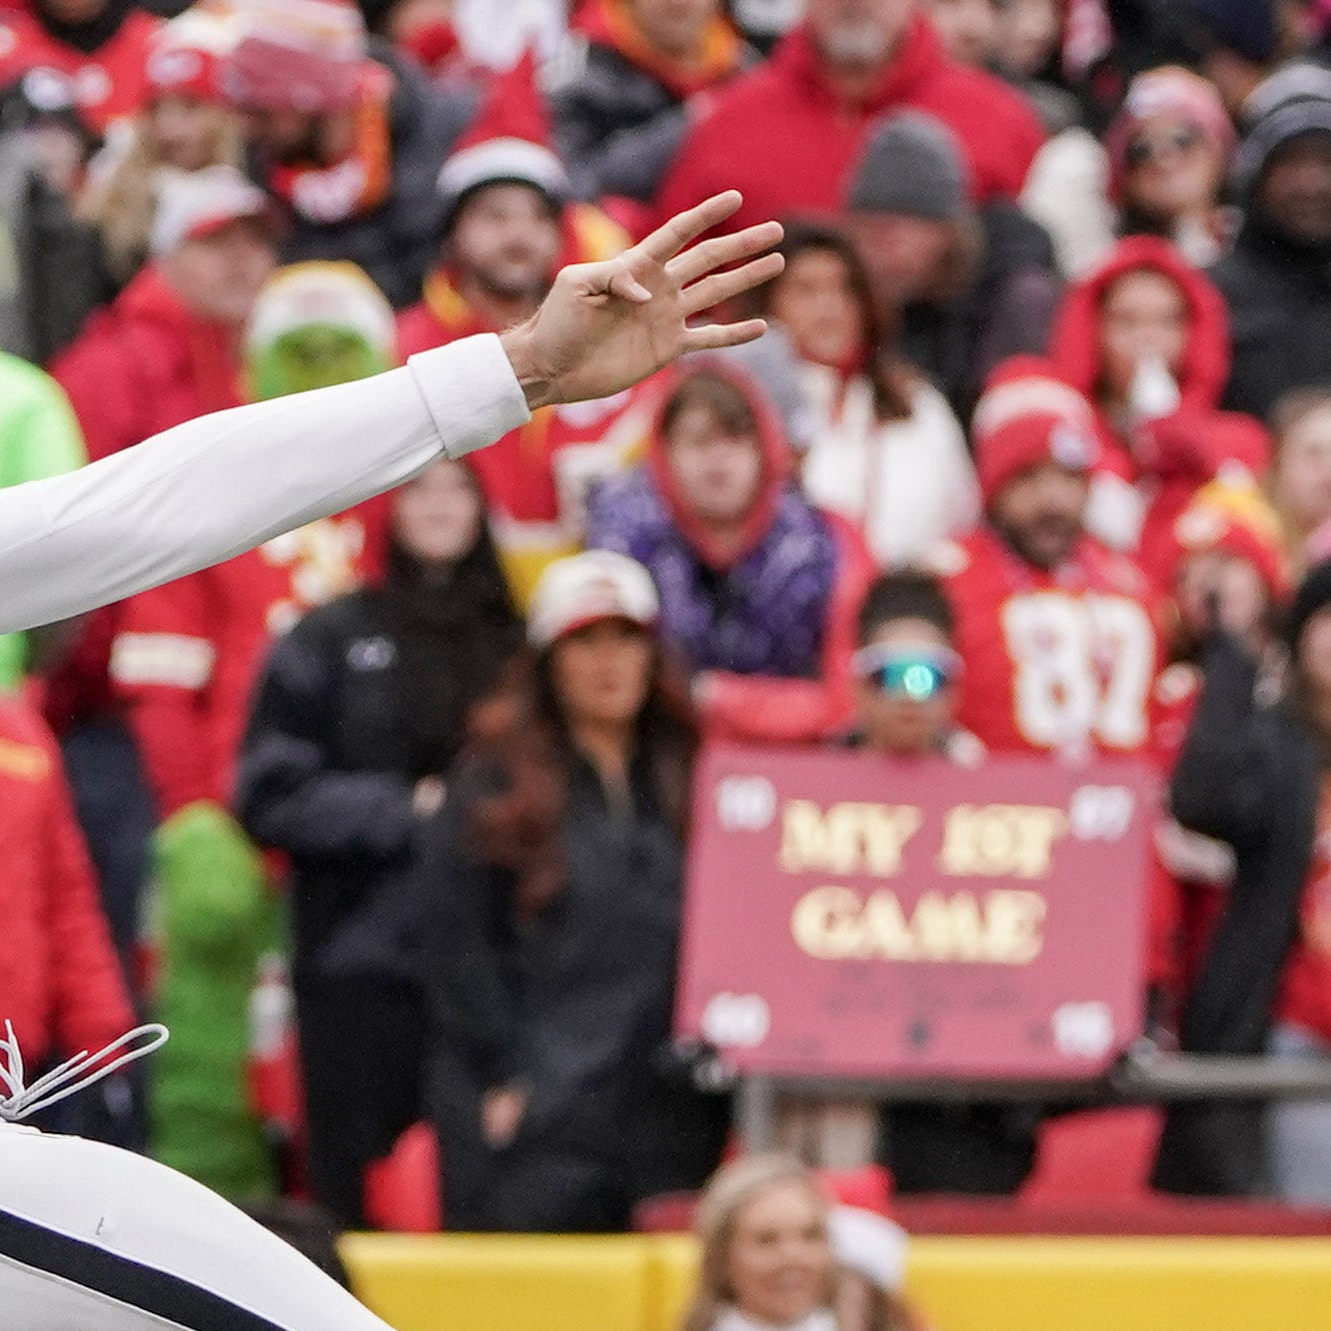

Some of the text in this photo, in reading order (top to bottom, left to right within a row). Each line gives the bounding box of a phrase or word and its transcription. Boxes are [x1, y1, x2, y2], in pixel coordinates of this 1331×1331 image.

[998, 588, 1157, 749] 87
[780, 800, 1069, 878] MY 1ST
[790, 885, 1047, 965] GAME
